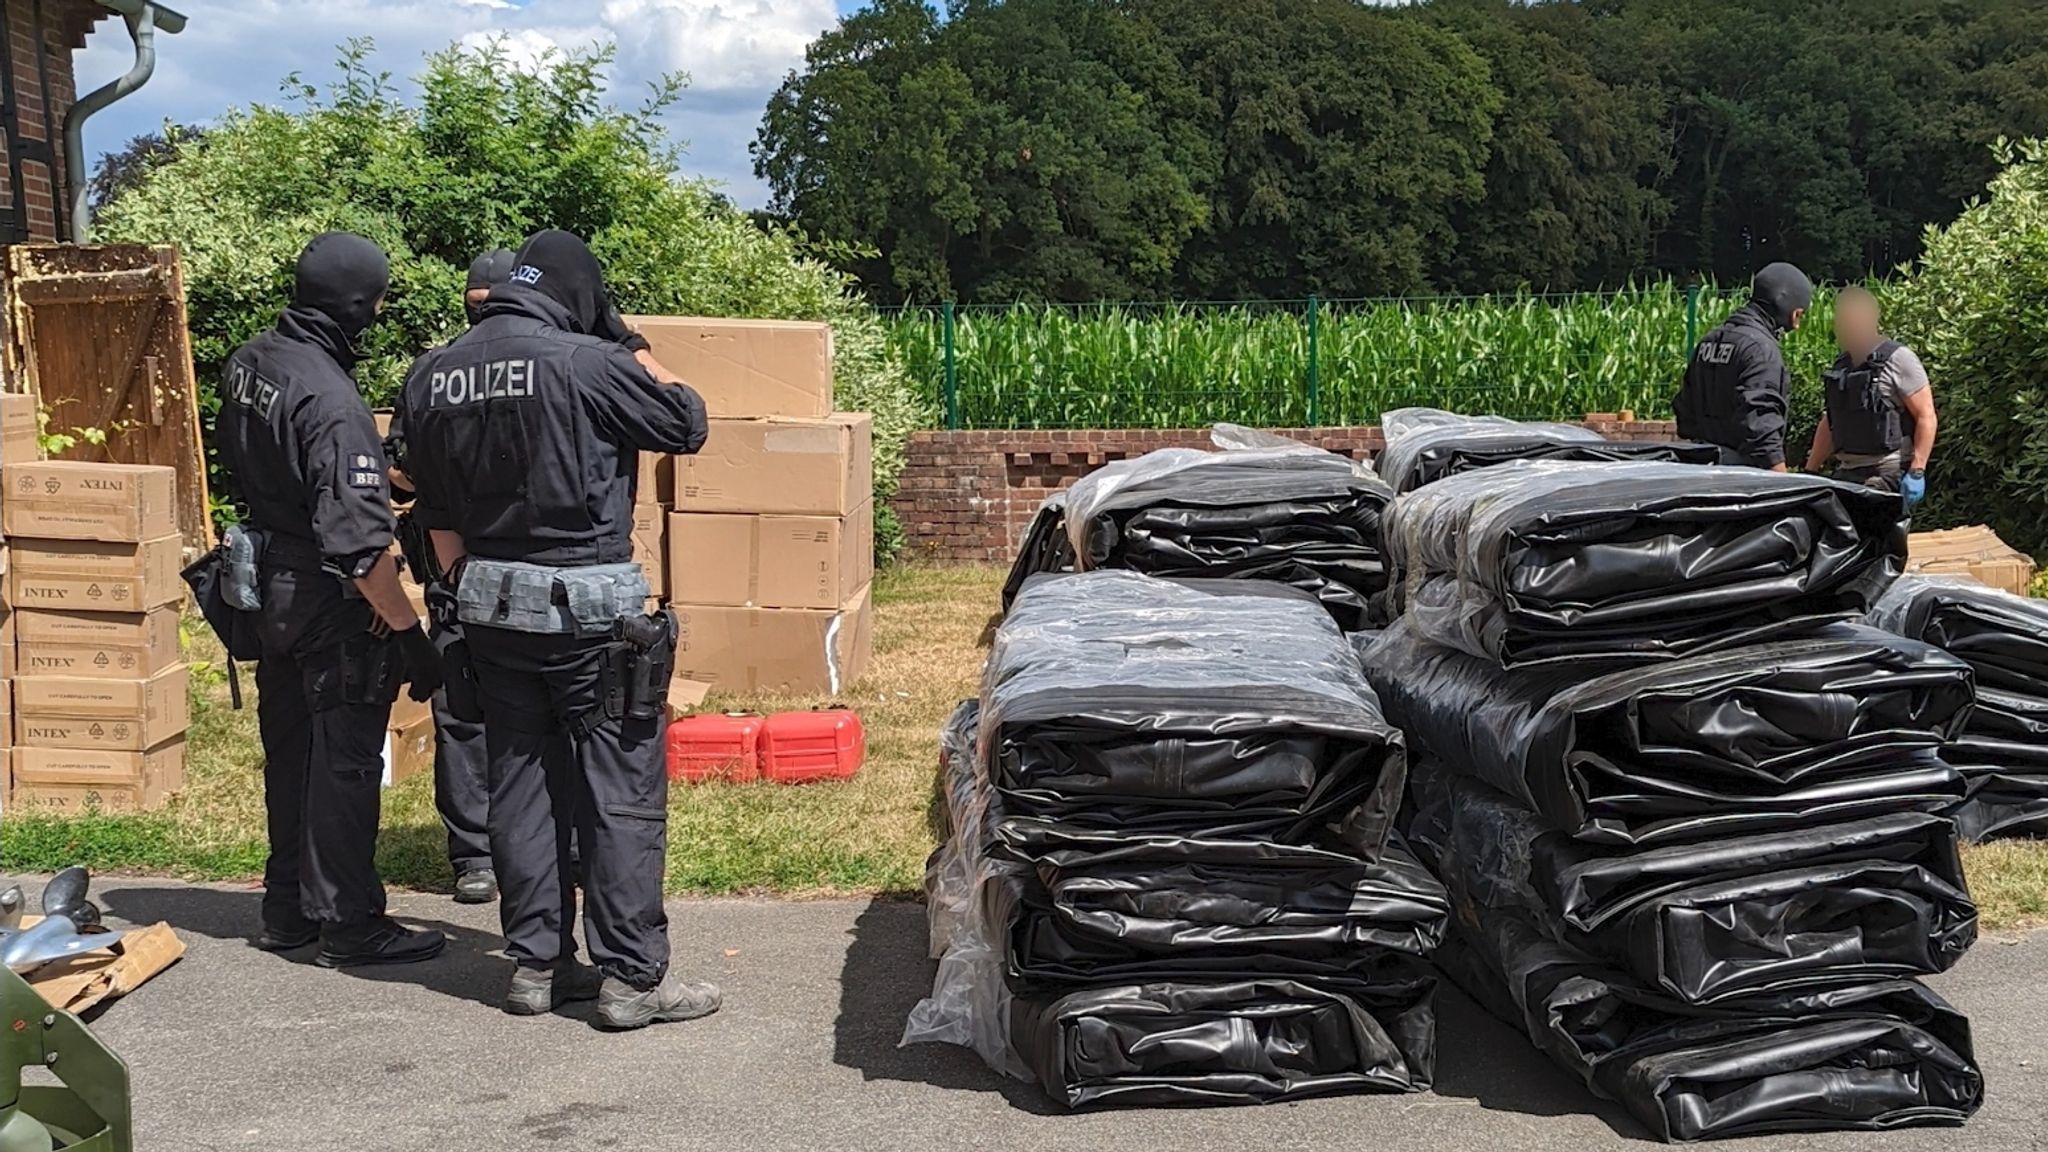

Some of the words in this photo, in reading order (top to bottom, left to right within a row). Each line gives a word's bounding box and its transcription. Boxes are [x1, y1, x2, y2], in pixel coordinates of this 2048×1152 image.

[510, 264, 544, 285] LIZEI
[430, 358, 535, 408] POLIZEI
[24, 587, 65, 599] INTEX
[31, 656, 71, 668] INTEX
[27, 728, 68, 739] INTEX
